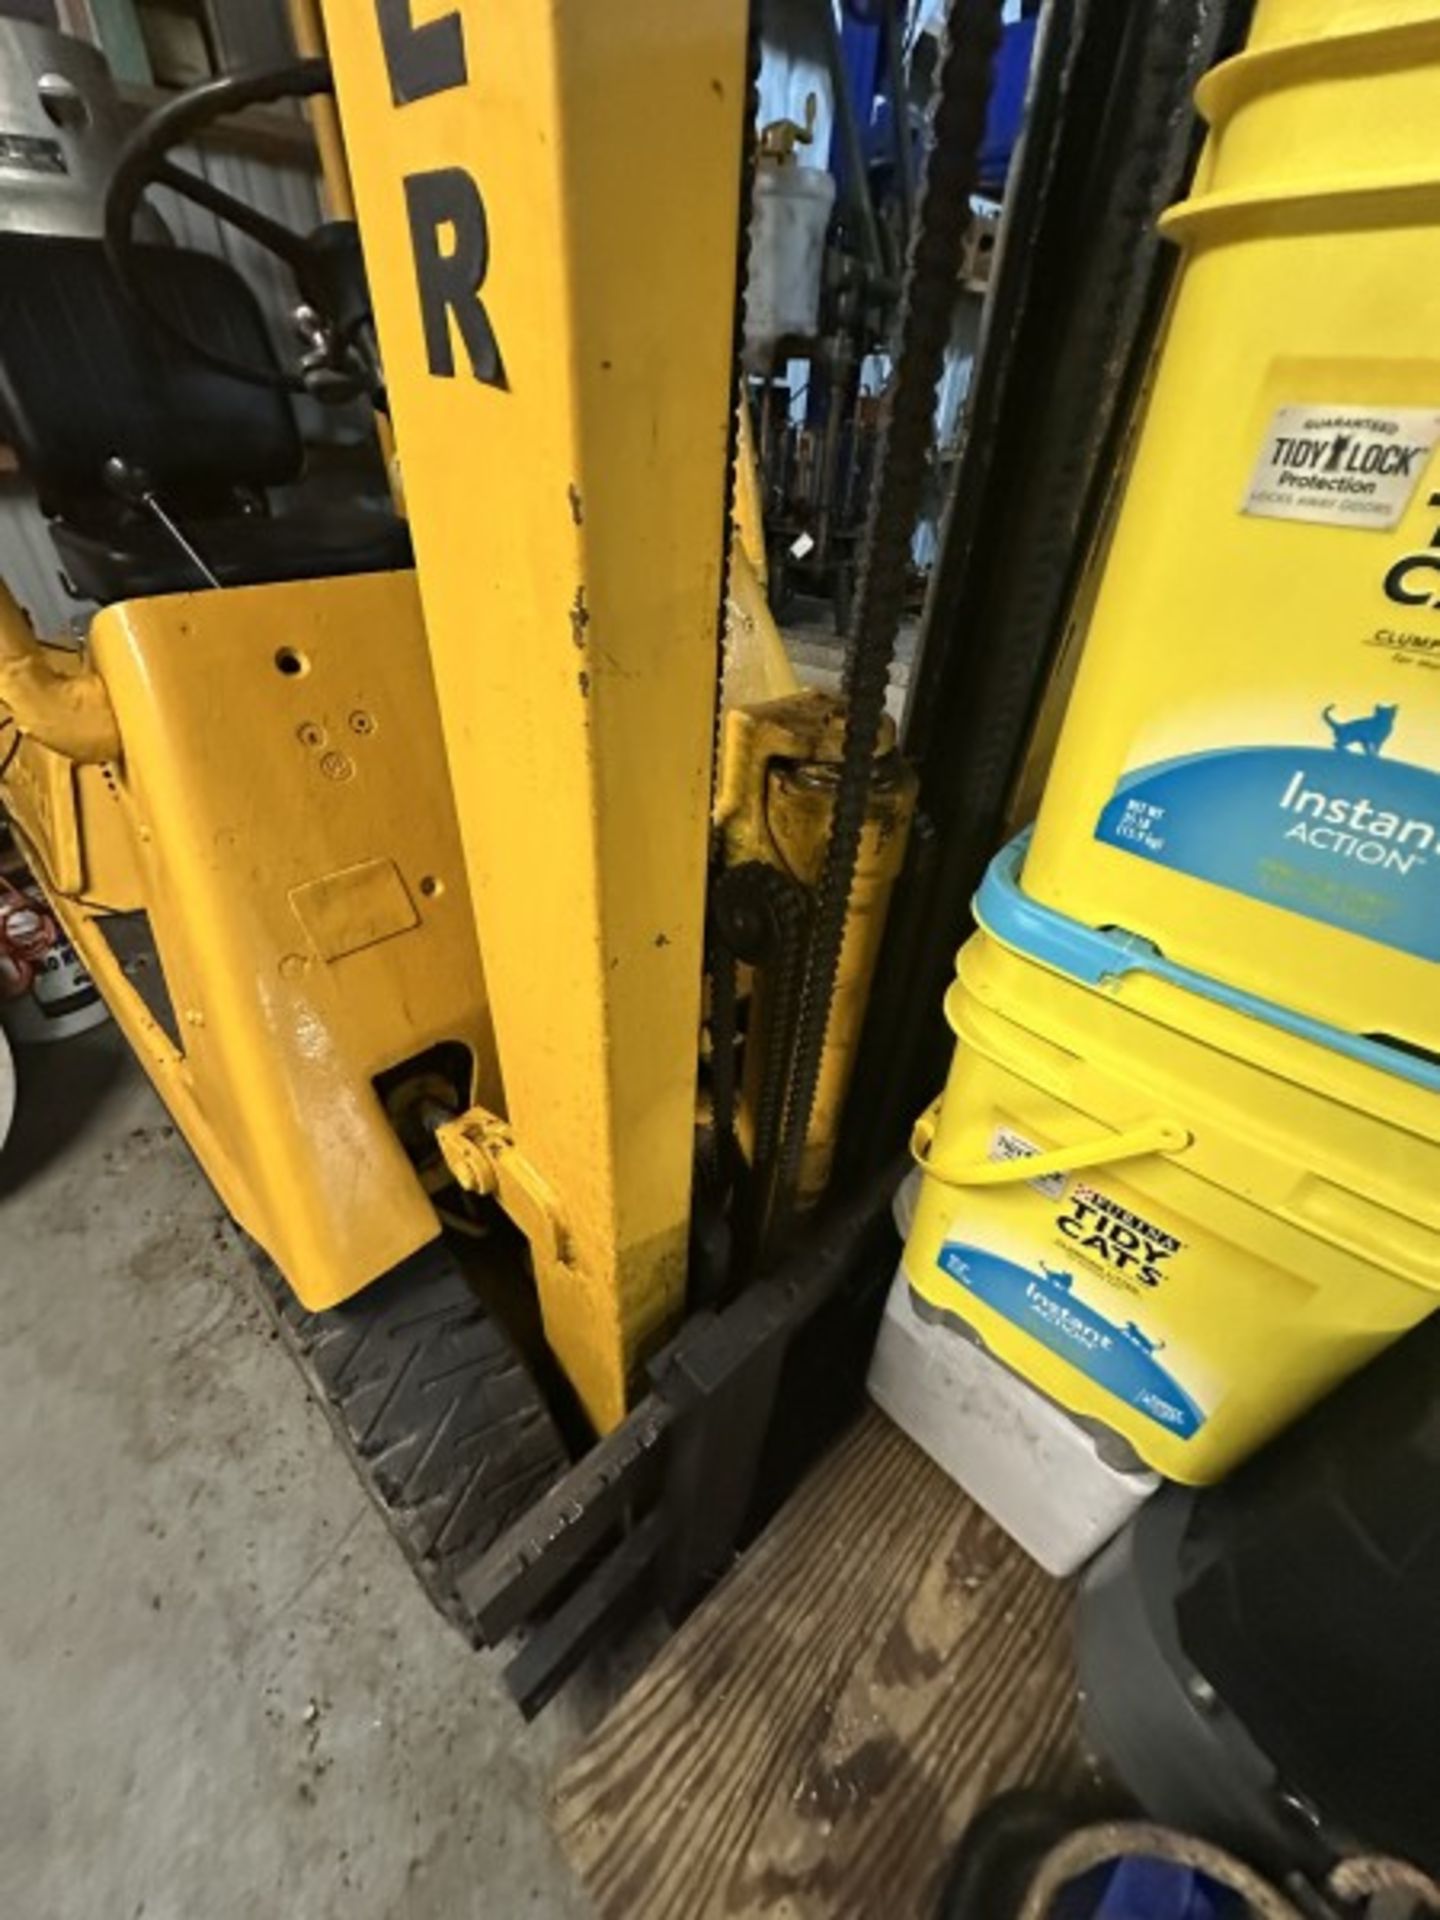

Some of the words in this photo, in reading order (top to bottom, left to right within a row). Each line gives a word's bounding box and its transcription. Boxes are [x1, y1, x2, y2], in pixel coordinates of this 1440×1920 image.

[1271, 438, 1329, 468] TIDY
[1278, 470, 1377, 494] Protection
[1279, 771, 1440, 855] Instan
[1057, 1216, 1162, 1287] CATS
[1070, 1197, 1171, 1263] TIDY
[1026, 1282, 1113, 1352] Instant
